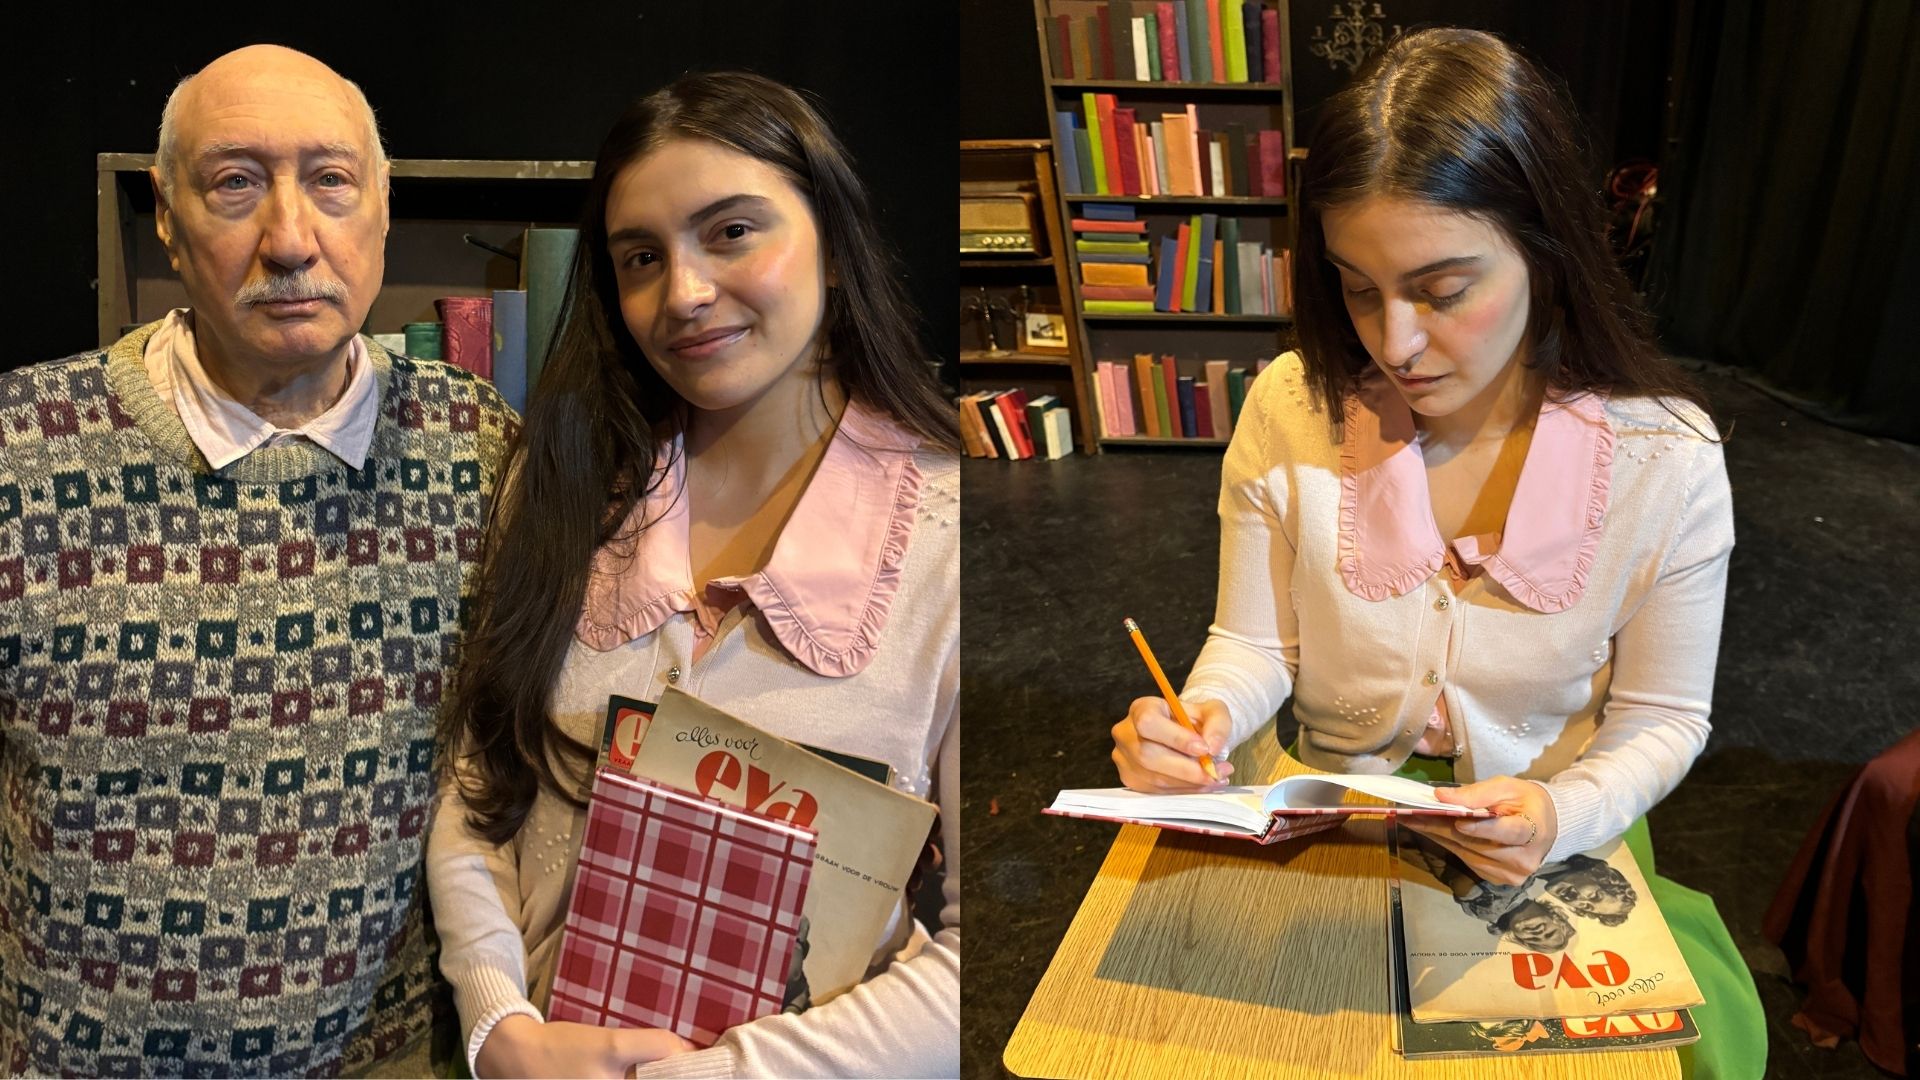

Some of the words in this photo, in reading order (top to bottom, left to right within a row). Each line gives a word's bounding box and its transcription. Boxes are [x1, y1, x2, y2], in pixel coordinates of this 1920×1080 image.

[675, 726, 720, 748] alles
[724, 736, 762, 760] voor
[695, 750, 819, 828] eva
[842, 865, 861, 877] VOOR
[862, 874, 873, 883] DE
[874, 879, 899, 893] VROUW
[1511, 950, 1631, 991] eva
[1629, 972, 1664, 995] alles
[1587, 988, 1626, 1006] voor
